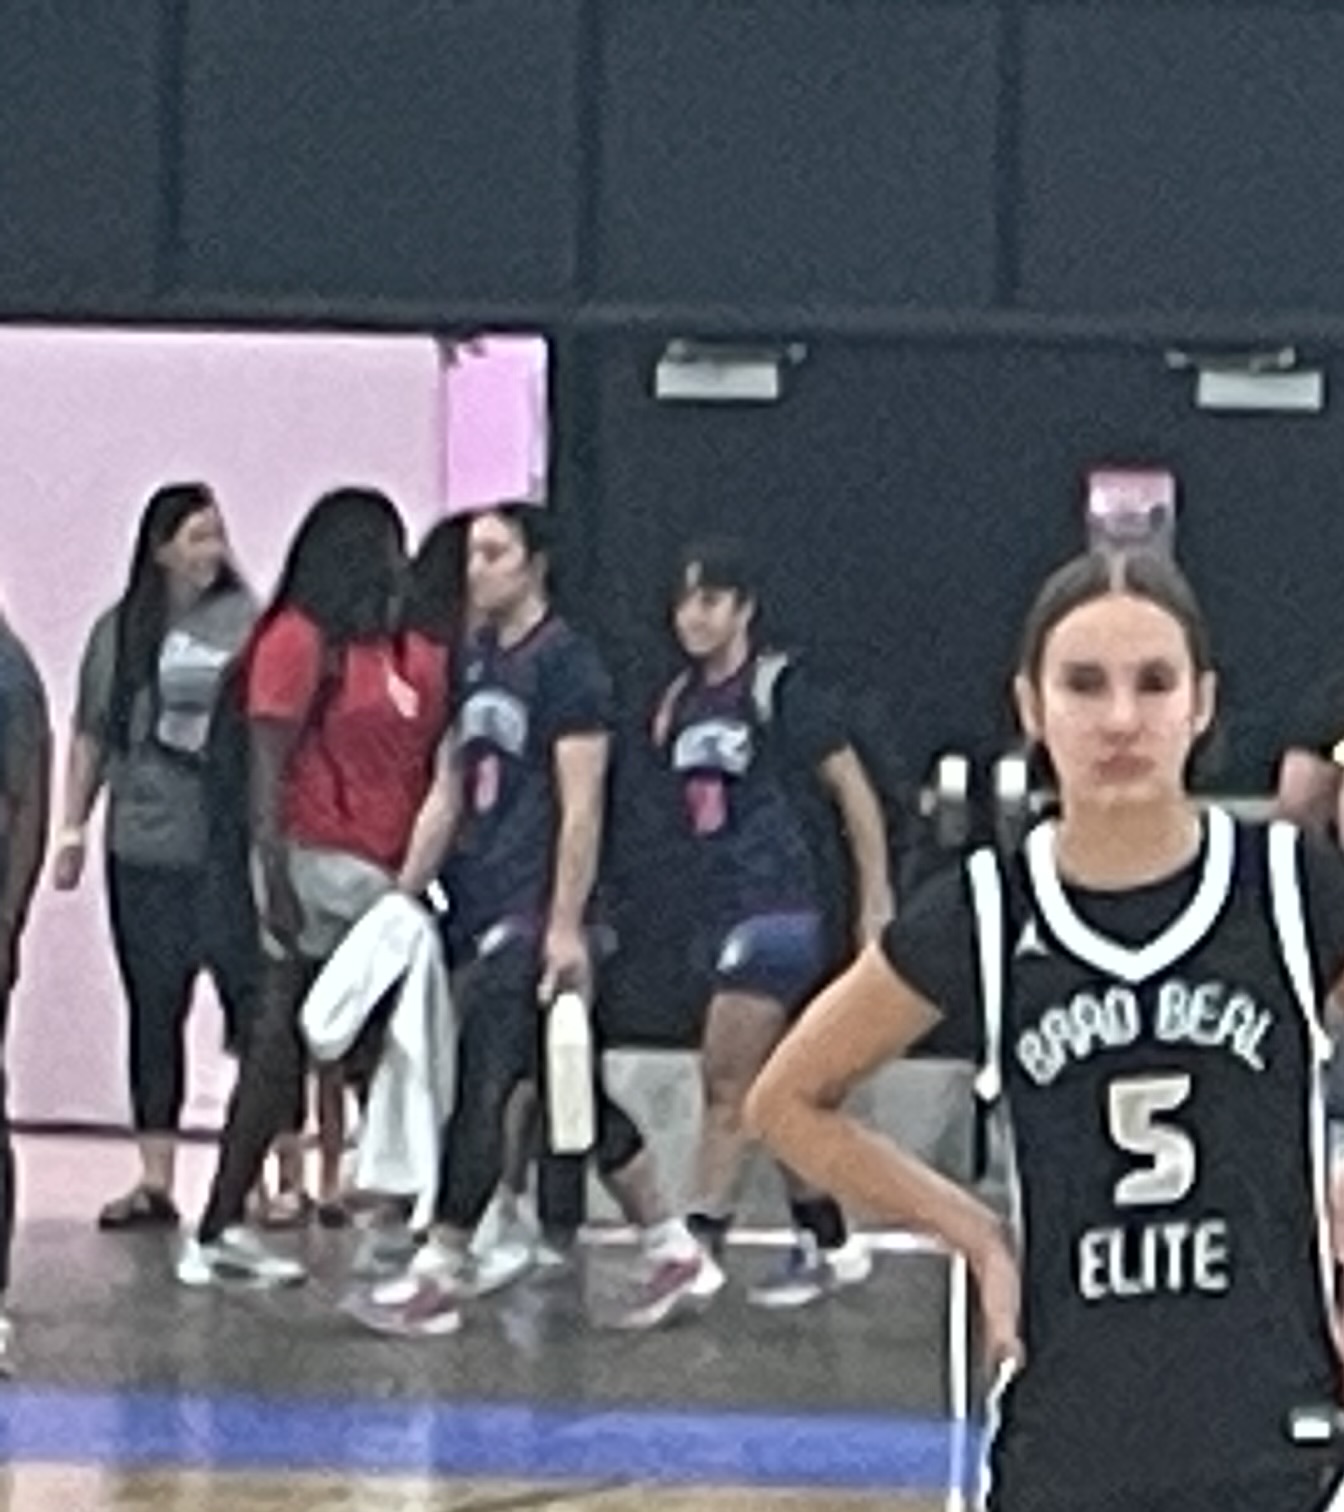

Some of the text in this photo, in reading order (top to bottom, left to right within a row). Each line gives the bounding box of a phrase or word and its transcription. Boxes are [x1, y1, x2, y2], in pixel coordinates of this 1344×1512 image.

[1015, 979, 1272, 1085] BRAD BEAL
[1108, 1072, 1197, 1206] 5
[1078, 1218, 1229, 1300] ELITE
